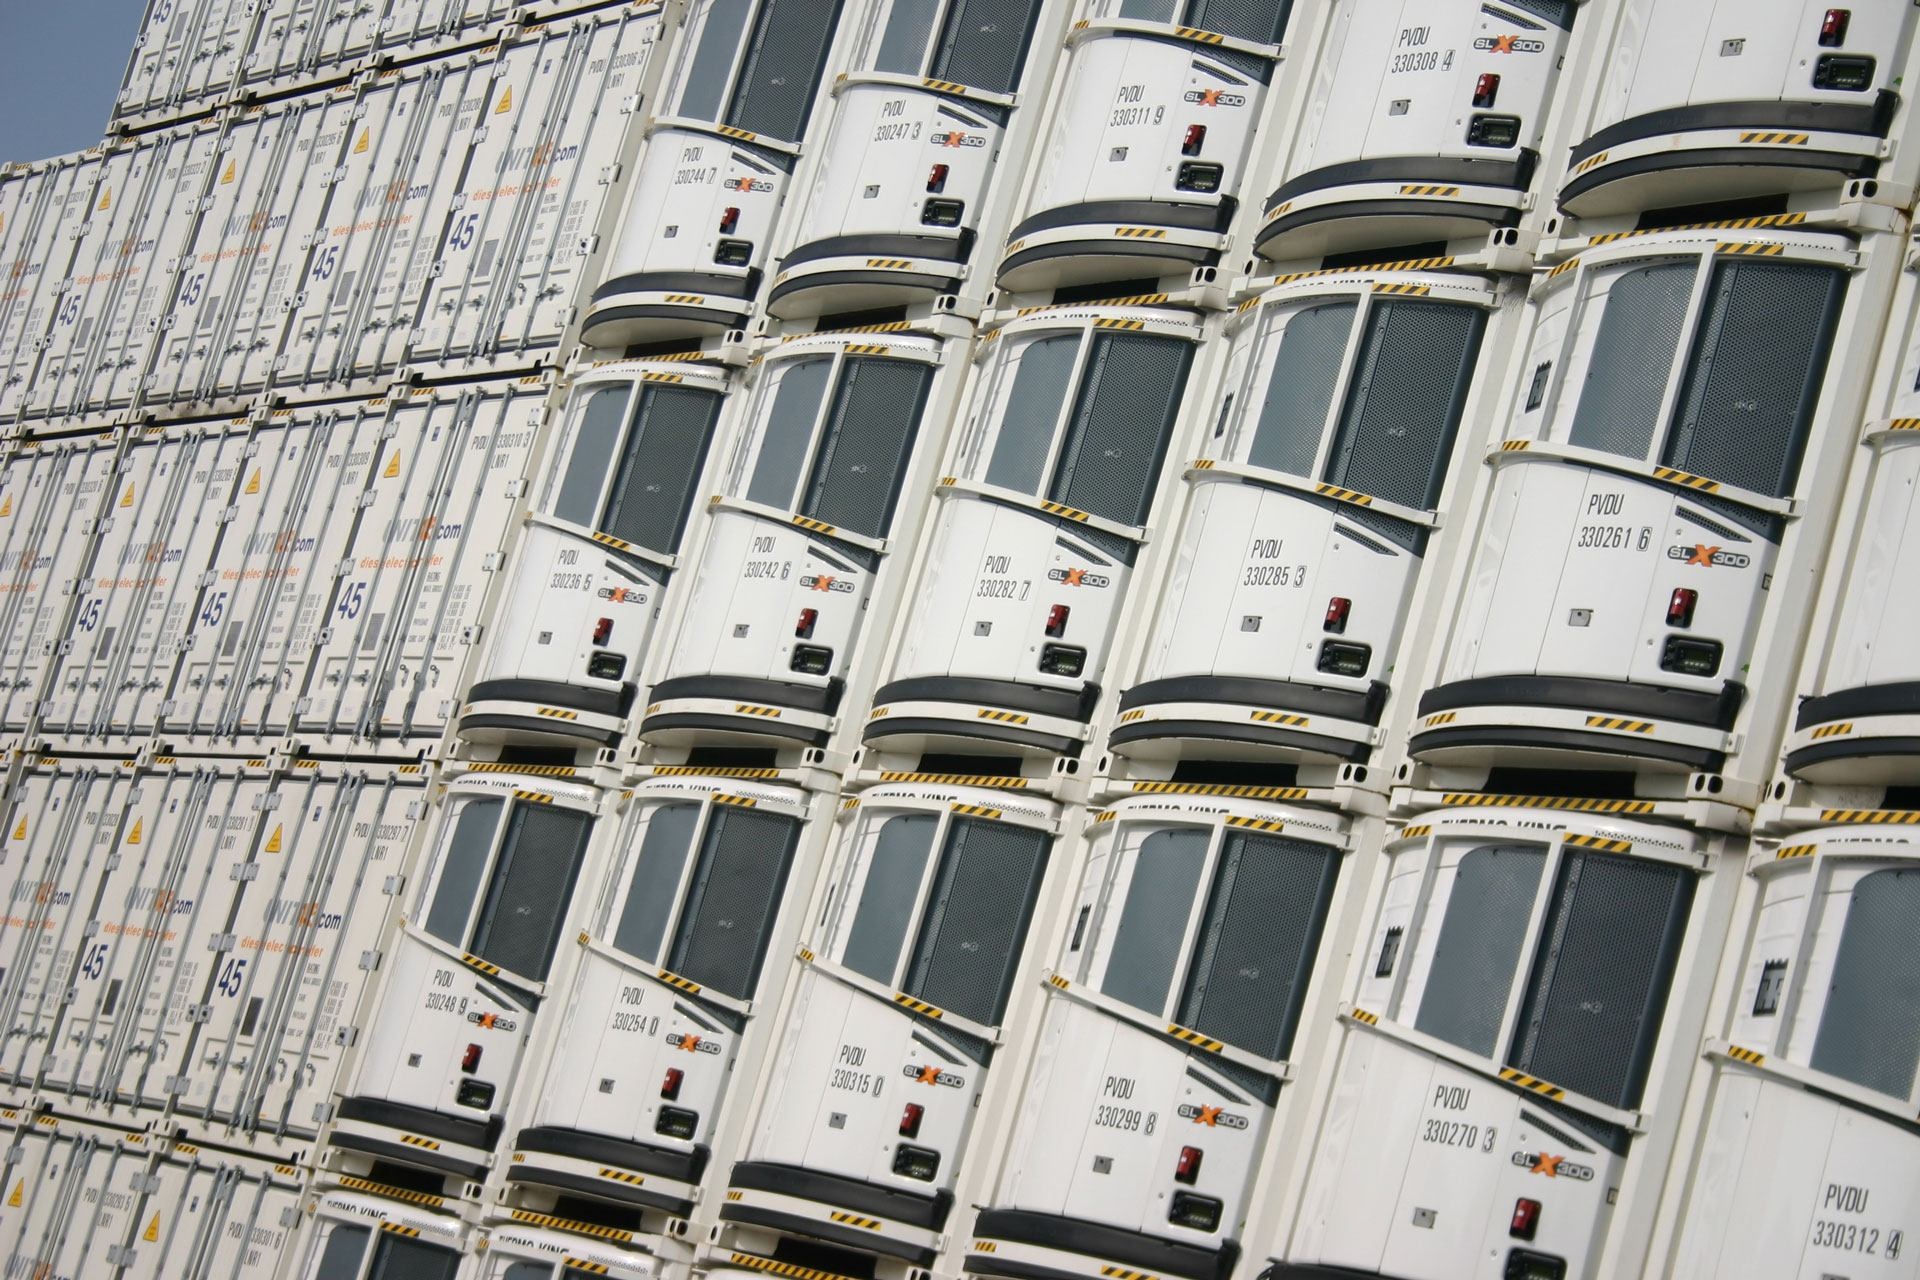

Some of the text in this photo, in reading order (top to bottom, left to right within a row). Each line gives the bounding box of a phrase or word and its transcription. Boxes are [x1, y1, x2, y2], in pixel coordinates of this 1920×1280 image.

[1398, 27, 1431, 48] PVDU
[1392, 50, 1456, 74] 330308 4
[1116, 85, 1146, 104] PVDU
[882, 100, 906, 118] PVDU
[1110, 105, 1166, 127] 330311 9
[874, 122, 922, 142] 330247 3
[682, 146, 703, 162] PVDU
[675, 167, 717, 185] 330244 7
[450, 214, 479, 252] 45
[312, 246, 340, 282] 45
[180, 274, 205, 307] 45
[59, 294, 82, 327] 45
[471, 435, 490, 450] PVDU
[522, 431, 531, 448] 3
[491, 454, 510, 469] LNR1
[1587, 494, 1625, 515] PVDU
[752, 536, 776, 554] PVDU
[1251, 539, 1283, 558] PVDU
[1578, 526, 1652, 551] 330261 6
[558, 550, 579, 566] PVDU
[984, 556, 1012, 574] PVDU
[744, 561, 792, 580] 330242 6
[1244, 566, 1306, 587] 330285 3
[550, 573, 593, 591] 330236 5
[976, 580, 1032, 600] 330282 7
[201, 592, 228, 627] 45
[338, 583, 366, 620] 45
[78, 599, 103, 632] 45
[353, 822, 409, 842] PVDU 330297 7
[370, 846, 388, 861] LNR1
[82, 944, 108, 980] 45
[218, 958, 242, 998] 45
[433, 969, 454, 988] PVDU
[425, 992, 468, 1015] 330248 9
[620, 986, 644, 1006] PVDU
[612, 1012, 660, 1036] 330254 0
[839, 1044, 866, 1066] PVDU
[831, 1069, 884, 1098] 330315 0
[1103, 1076, 1136, 1100] PVDU
[1433, 1084, 1470, 1112] PVDU
[1096, 1104, 1158, 1136] 330299 8
[1424, 1118, 1498, 1154] 330270 3
[1824, 1184, 1870, 1214] PVDU
[227, 1222, 245, 1240] PVDU
[274, 1233, 282, 1250] 6
[1812, 1220, 1903, 1261] 330312 4
[243, 1248, 262, 1267] LNR1
